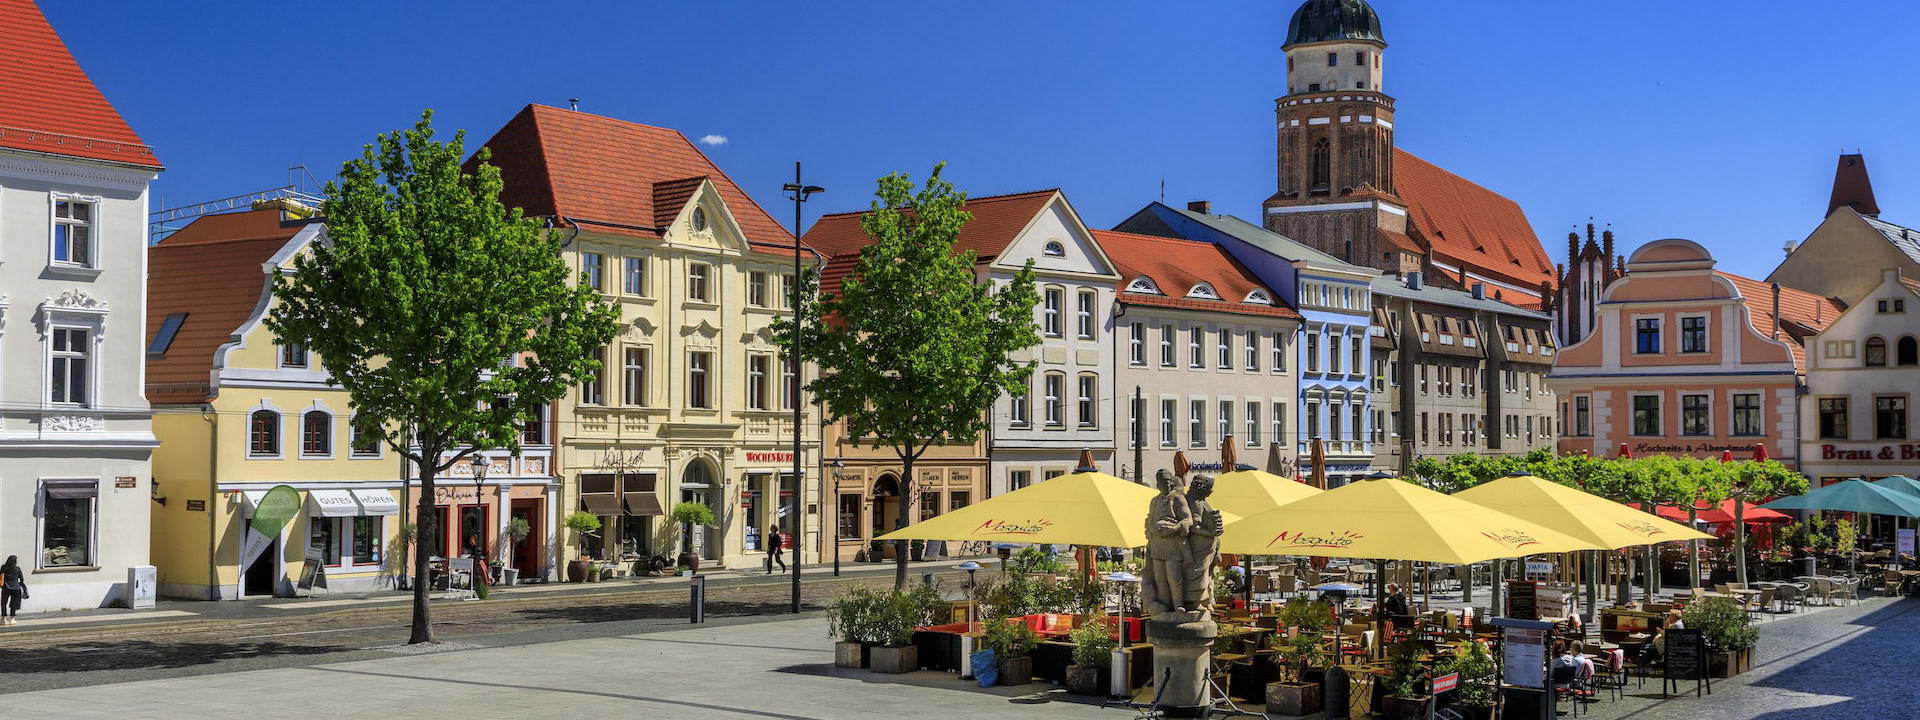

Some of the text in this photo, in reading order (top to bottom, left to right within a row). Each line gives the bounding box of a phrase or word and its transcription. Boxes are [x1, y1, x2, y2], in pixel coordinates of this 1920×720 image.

[1694, 443, 1755, 453] Abendmode
[1821, 444, 1872, 460] Brau
[1877, 446, 1894, 460] &
[319, 497, 352, 505] GUTES
[360, 495, 394, 503] HÖREN
